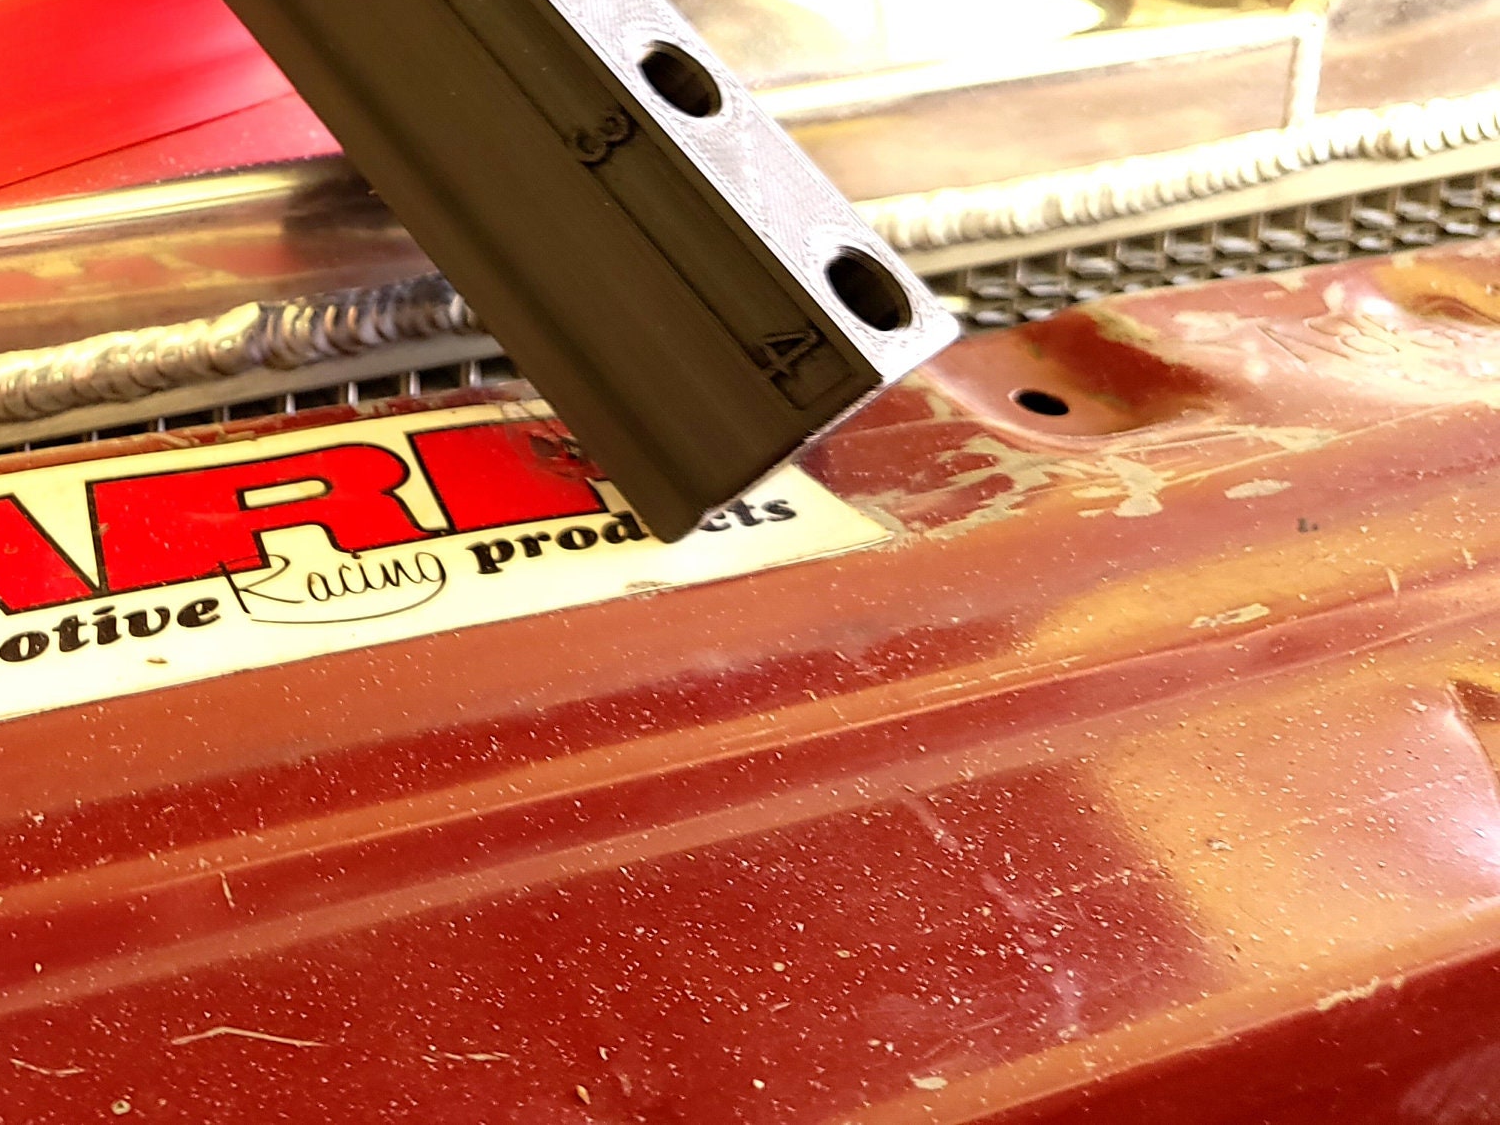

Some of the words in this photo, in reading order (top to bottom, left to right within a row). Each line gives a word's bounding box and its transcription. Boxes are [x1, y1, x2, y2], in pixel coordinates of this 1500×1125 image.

[576, 107, 637, 167] 3
[755, 327, 826, 378] 4
[217, 549, 448, 625] Racing
